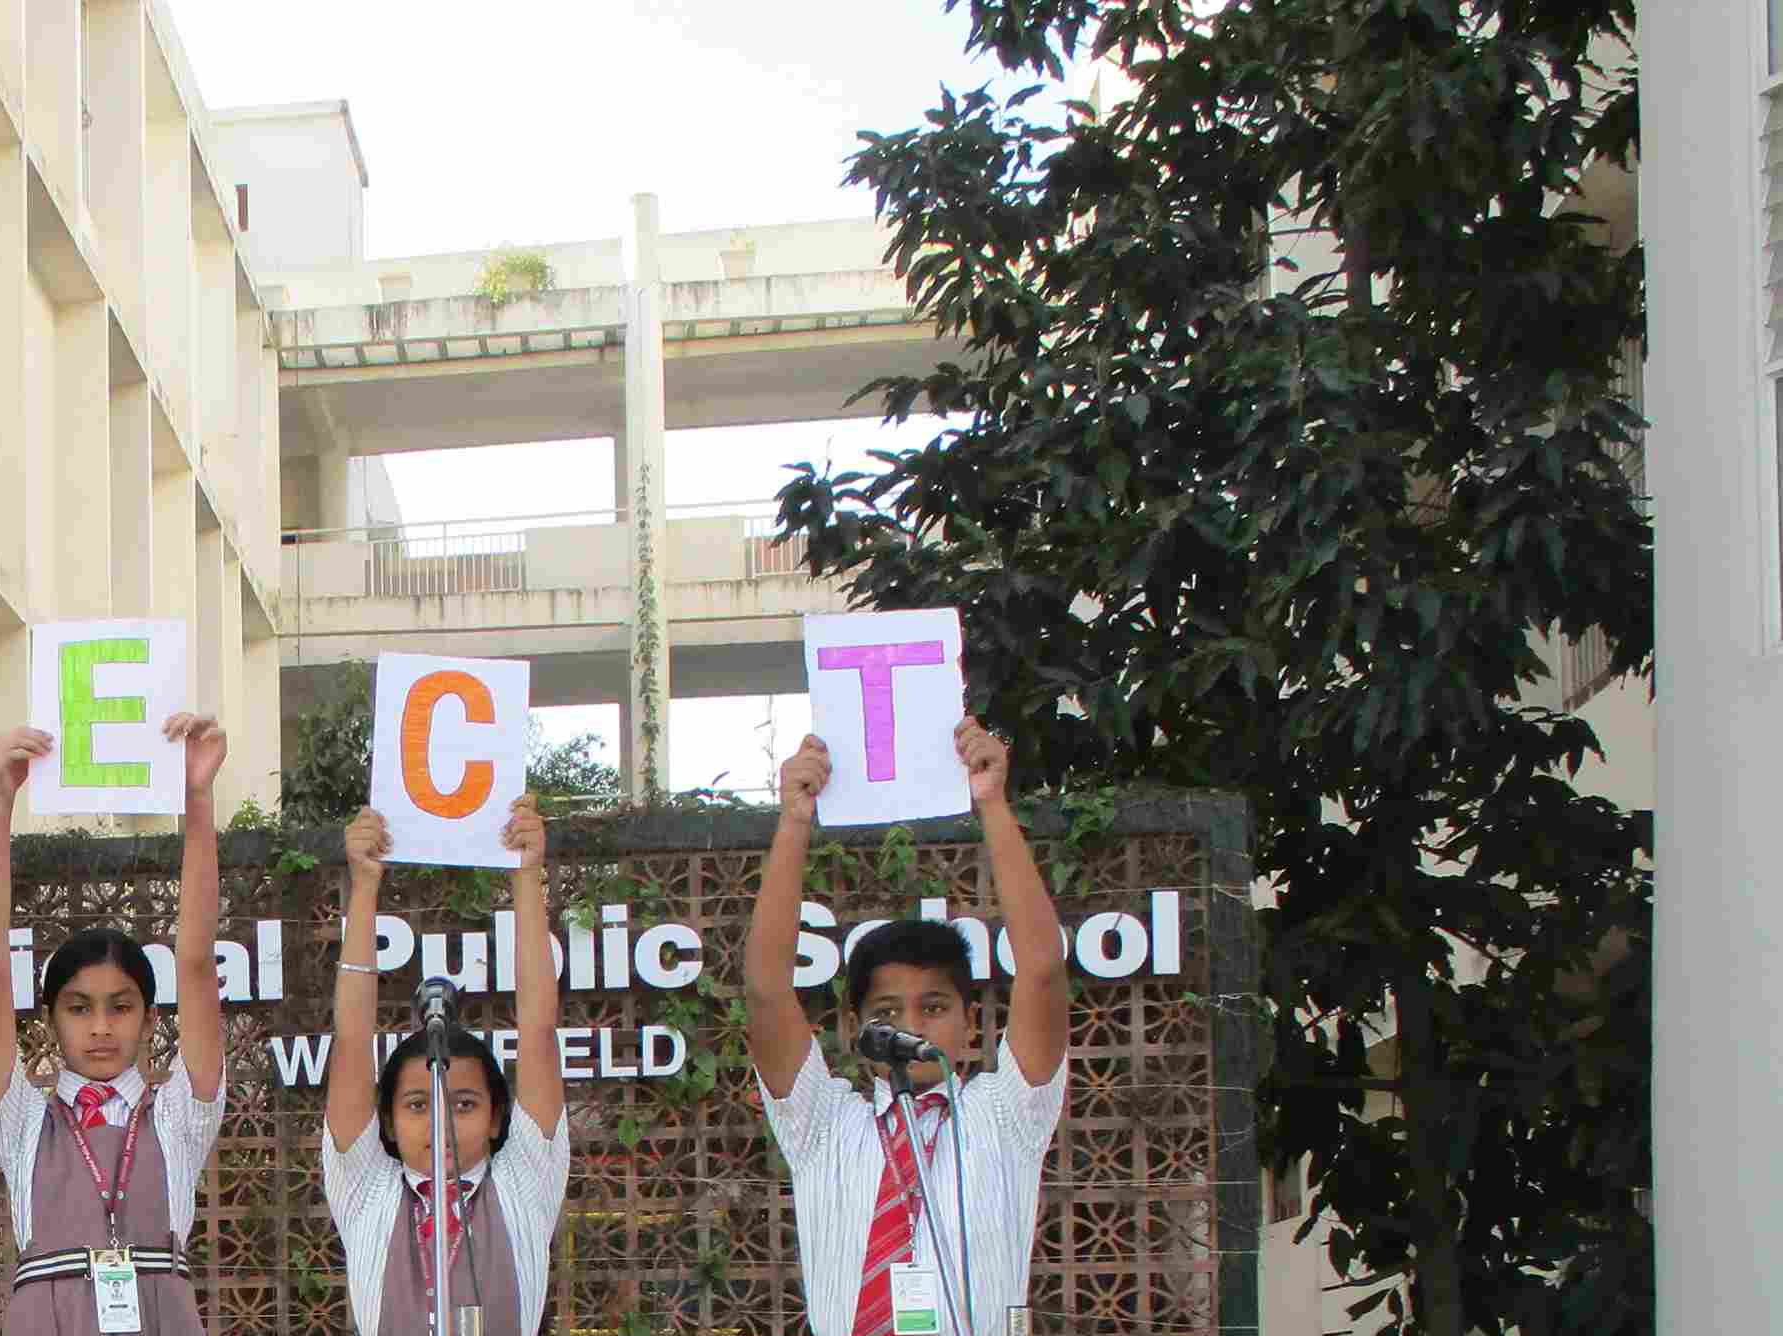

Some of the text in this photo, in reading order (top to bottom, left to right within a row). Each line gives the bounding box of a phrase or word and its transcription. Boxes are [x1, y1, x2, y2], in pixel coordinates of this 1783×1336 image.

[59, 637, 150, 788] E
[400, 670, 496, 819] C
[818, 640, 944, 782] T
[794, 890, 1180, 988] Shol
